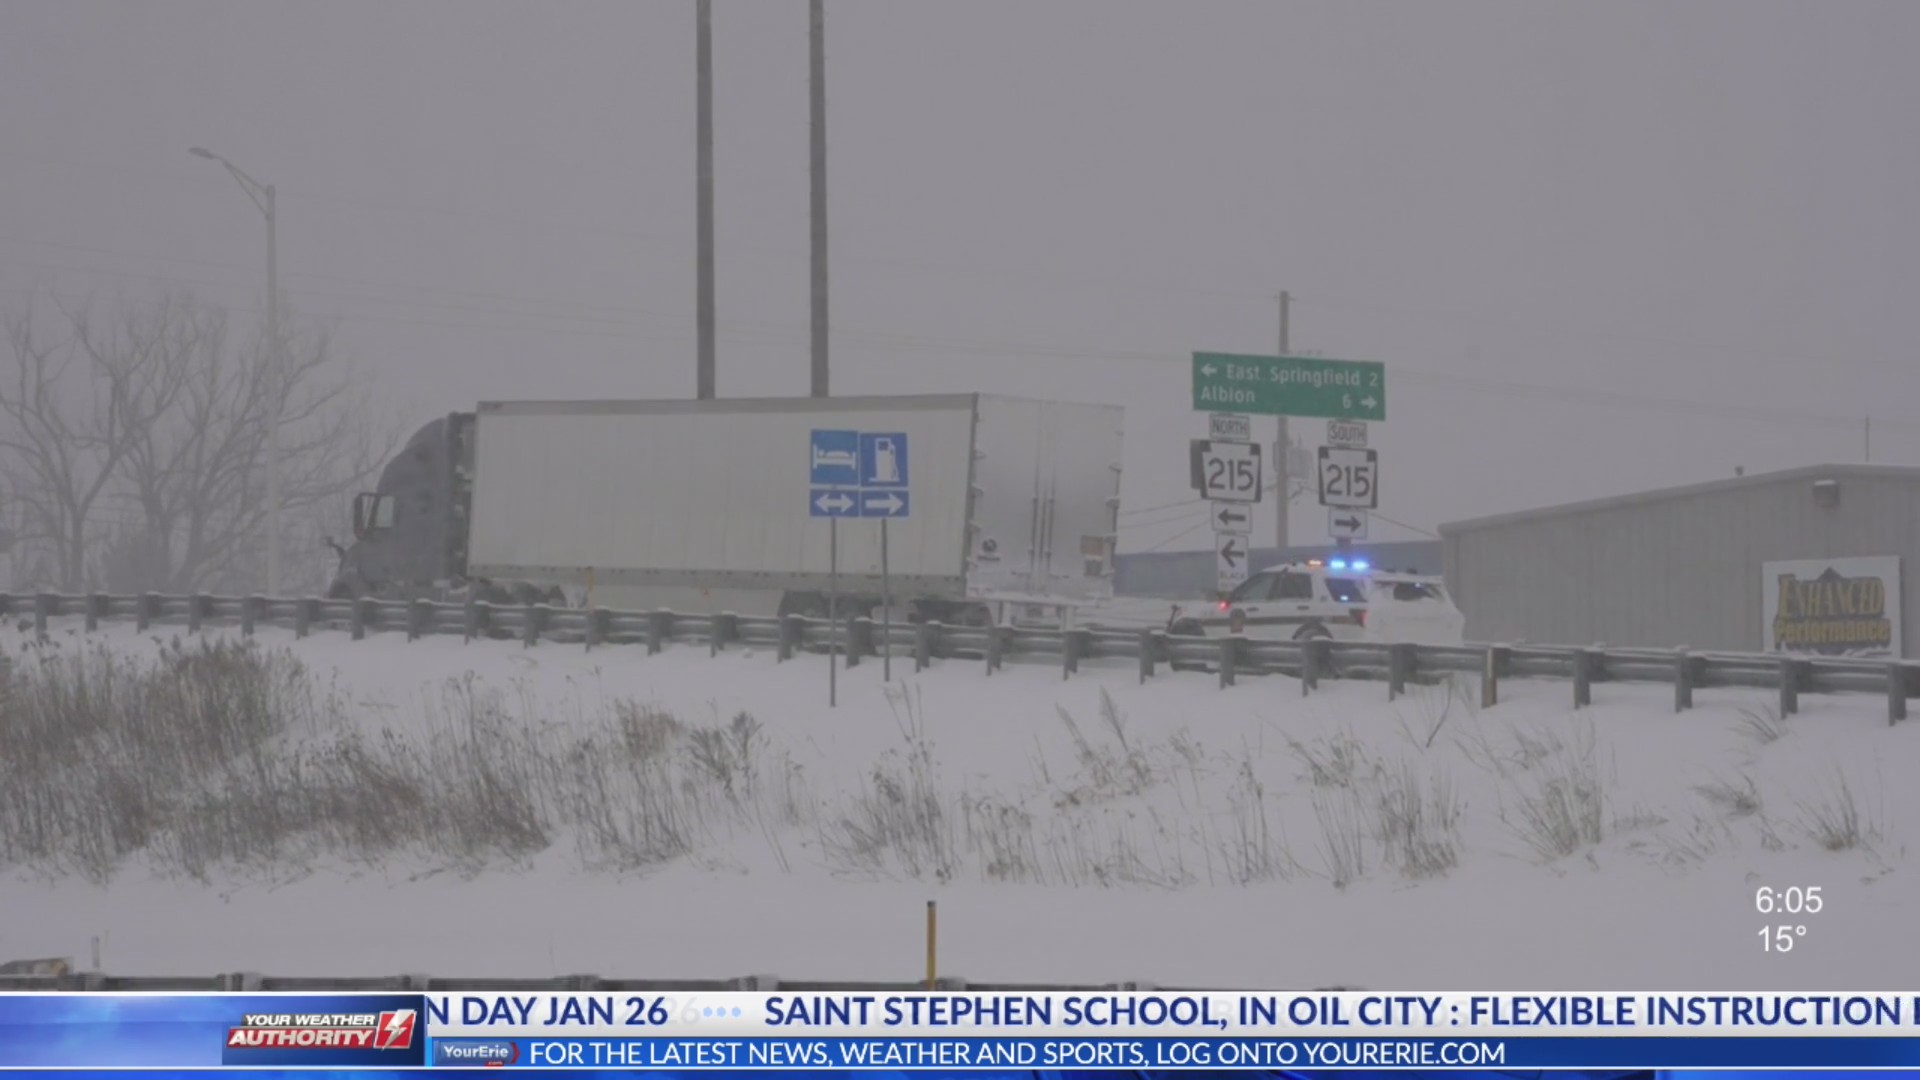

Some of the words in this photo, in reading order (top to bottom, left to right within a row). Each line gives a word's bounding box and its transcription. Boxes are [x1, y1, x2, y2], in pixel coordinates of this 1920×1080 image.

[1226, 364, 1260, 381] East
[1270, 366, 1360, 388] Springfield
[1369, 372, 1378, 387] 2
[1201, 386, 1256, 403] Albion
[1342, 394, 1352, 409] 6
[1212, 418, 1248, 436] NORTH
[1330, 424, 1365, 442] SOUTH
[1208, 457, 1254, 492] 215
[1325, 464, 1371, 498] 215
